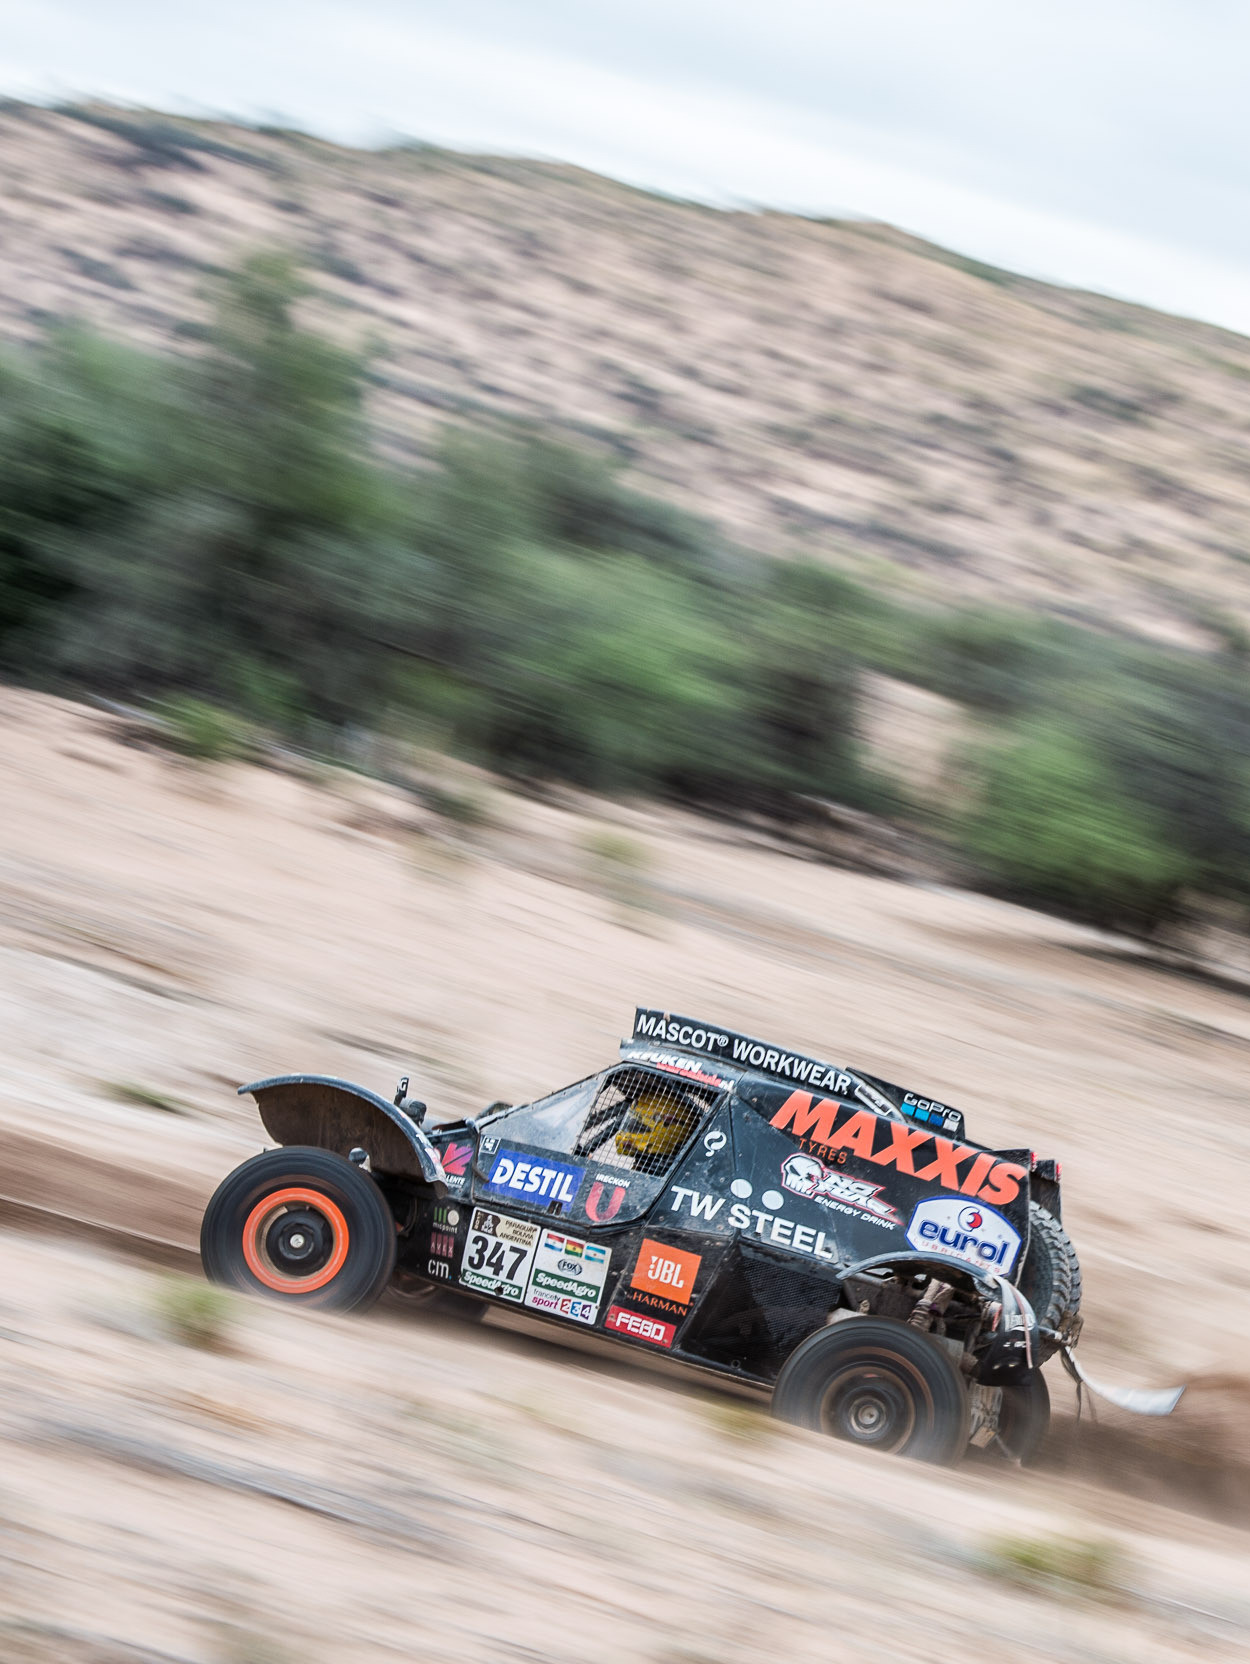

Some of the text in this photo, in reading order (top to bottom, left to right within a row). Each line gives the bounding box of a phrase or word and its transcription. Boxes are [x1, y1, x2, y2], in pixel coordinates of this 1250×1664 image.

[903, 1093, 961, 1122] GoPro
[768, 1089, 1028, 1205] MAXXIS
[799, 1138, 848, 1164] TYRES
[492, 1158, 574, 1203] DESTIL
[670, 1185, 833, 1259] TW STEEL
[814, 1196, 896, 1230] ENERGY DRINK
[919, 1219, 1008, 1266] eurol
[467, 1235, 528, 1281] 347
[562, 1260, 578, 1271] FOX
[647, 1256, 685, 1288] JBL
[536, 1273, 596, 1298] SpeedAgro
[532, 1296, 559, 1309] sport
[633, 1291, 688, 1316] HARMAN
[615, 1312, 665, 1341] FEBO
